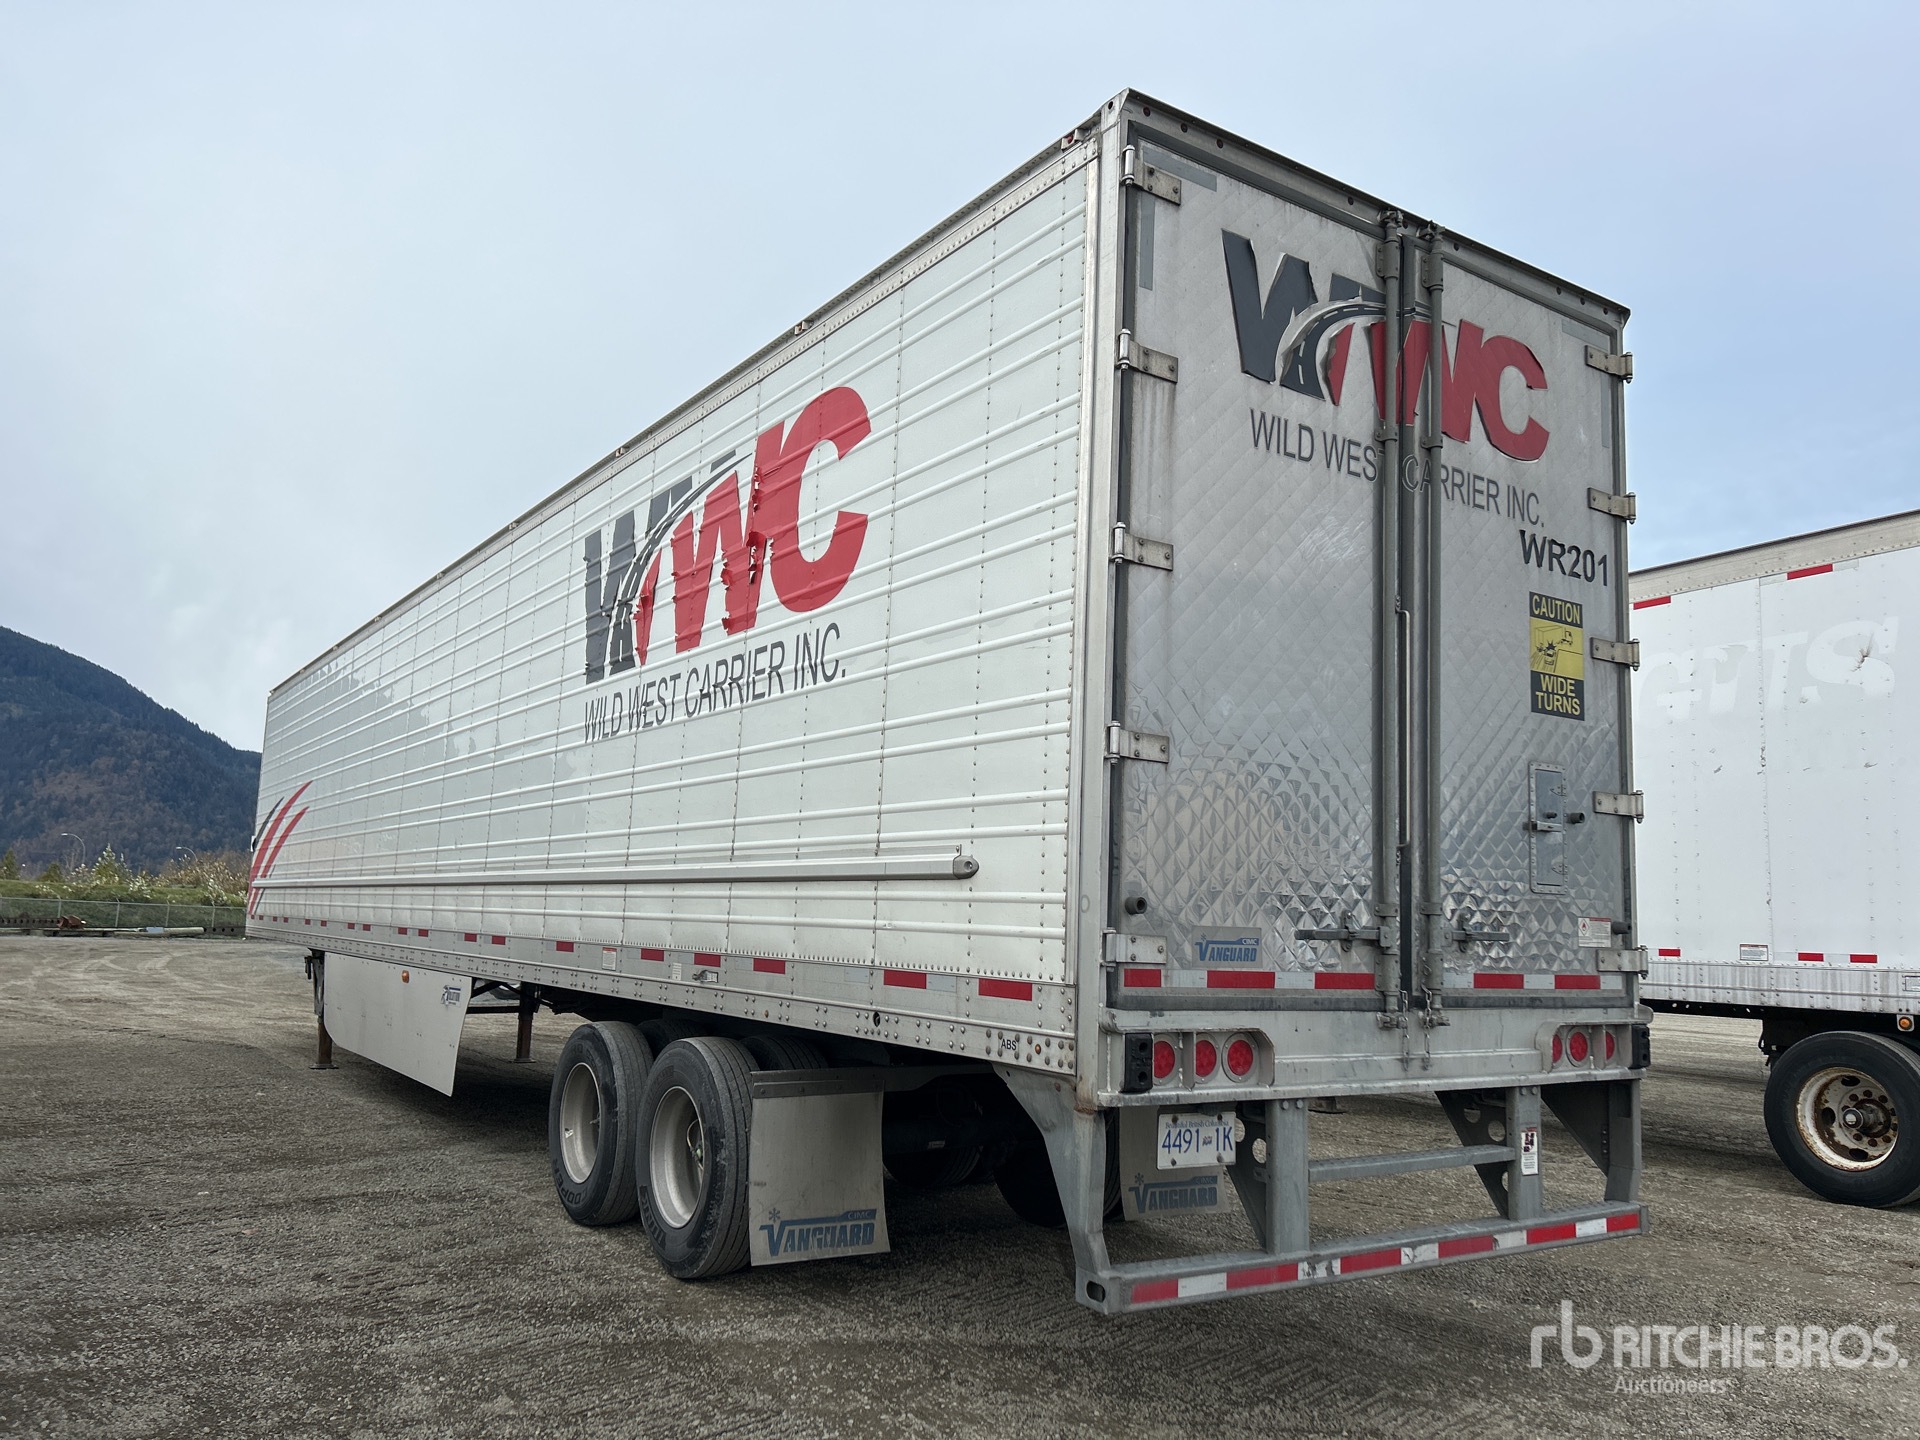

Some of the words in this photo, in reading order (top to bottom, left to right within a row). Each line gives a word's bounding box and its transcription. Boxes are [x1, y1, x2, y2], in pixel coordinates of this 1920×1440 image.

[1250, 408, 1315, 463] WILD
[1322, 430, 1385, 482] WES
[1507, 485, 1544, 528] INC.
[1519, 529, 1608, 587] WR201
[1532, 594, 1581, 626] CAUTION
[584, 691, 623, 744] WILD
[628, 672, 682, 732] WEST
[684, 640, 786, 718] CARRIER
[793, 622, 846, 691] INC.
[1540, 673, 1576, 698] WIDE
[1535, 691, 1581, 717] TURNS
[1194, 939, 1258, 962] VANGUARD
[1001, 1038, 1017, 1051] ABS
[1161, 1128, 1200, 1154] 4491
[1215, 1126, 1234, 1152] 1K
[1128, 1183, 1218, 1214] VANGUARD
[847, 1210, 873, 1221] CIMC
[759, 1220, 876, 1257] VANGUARD
